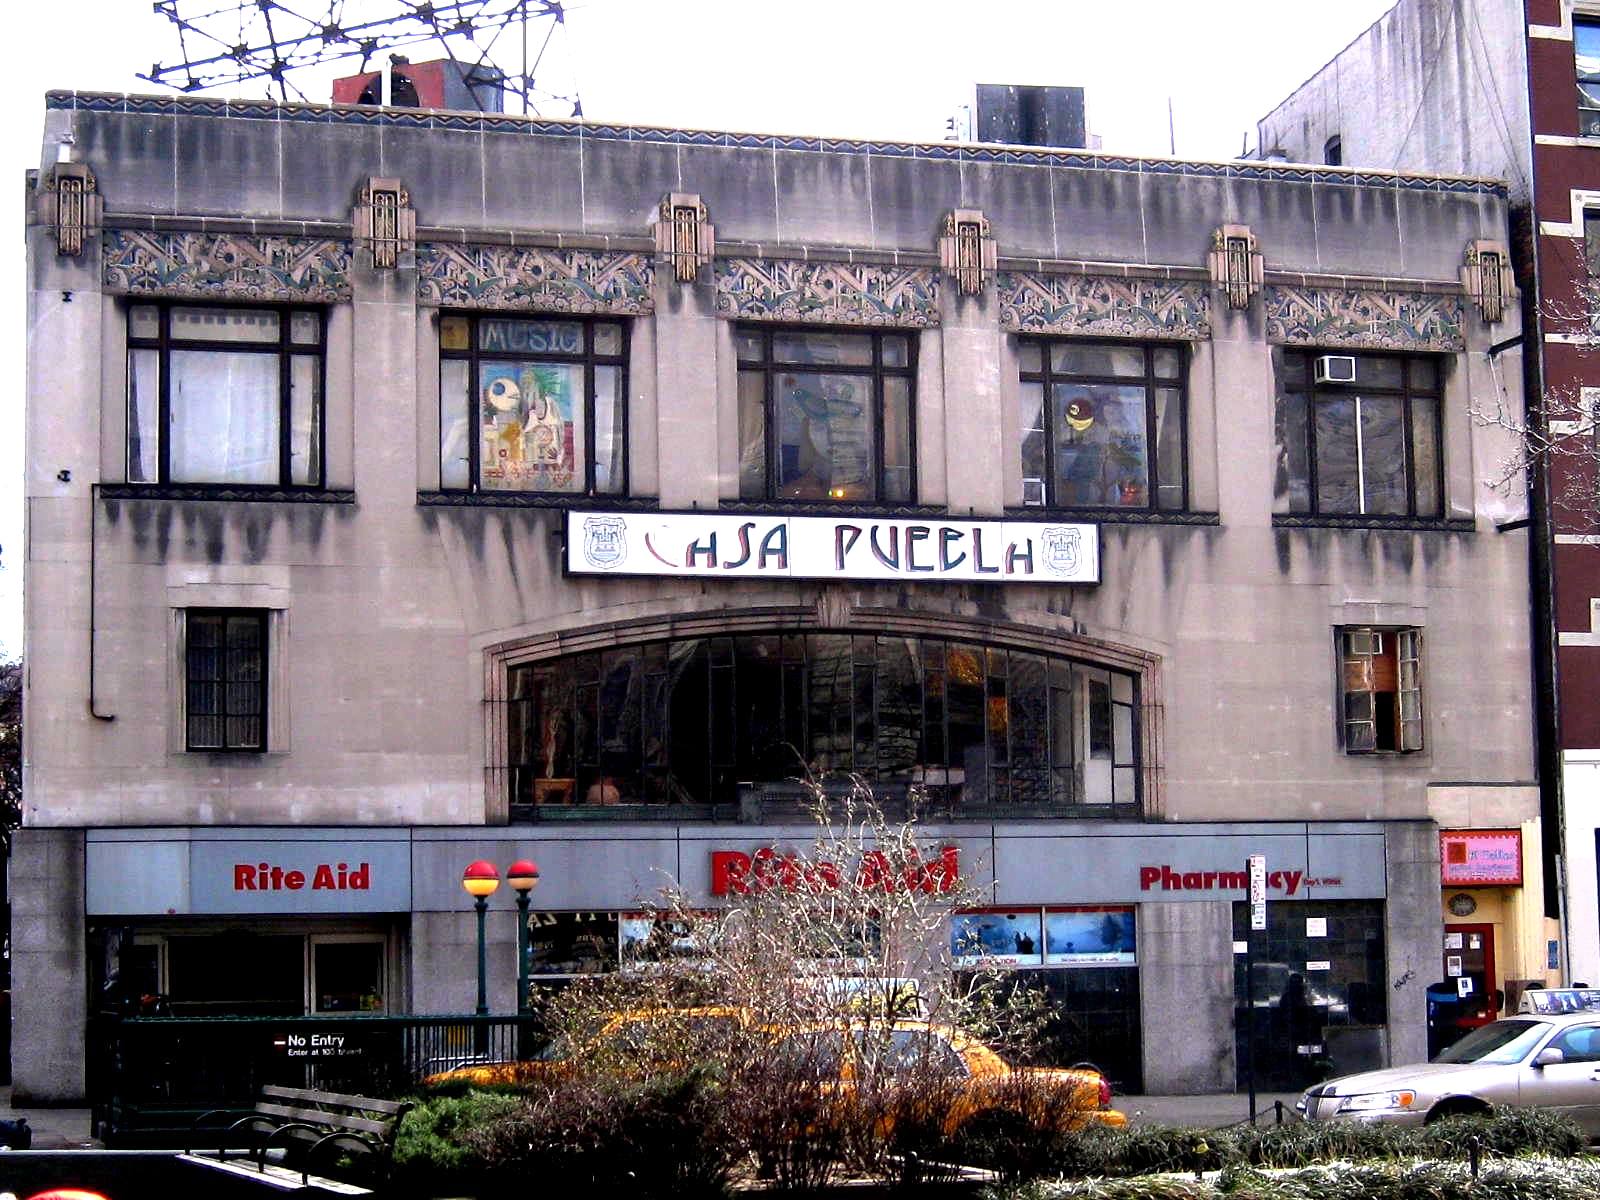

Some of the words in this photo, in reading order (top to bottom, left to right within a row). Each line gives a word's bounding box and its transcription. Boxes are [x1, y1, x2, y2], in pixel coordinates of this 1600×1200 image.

[484, 322, 577, 351] MUSIC
[234, 863, 304, 890] Rite
[312, 862, 370, 890] Aid
[1140, 865, 1303, 895] Pharmcy
[288, 1034, 306, 1047] No
[311, 1034, 345, 1048] Entry
